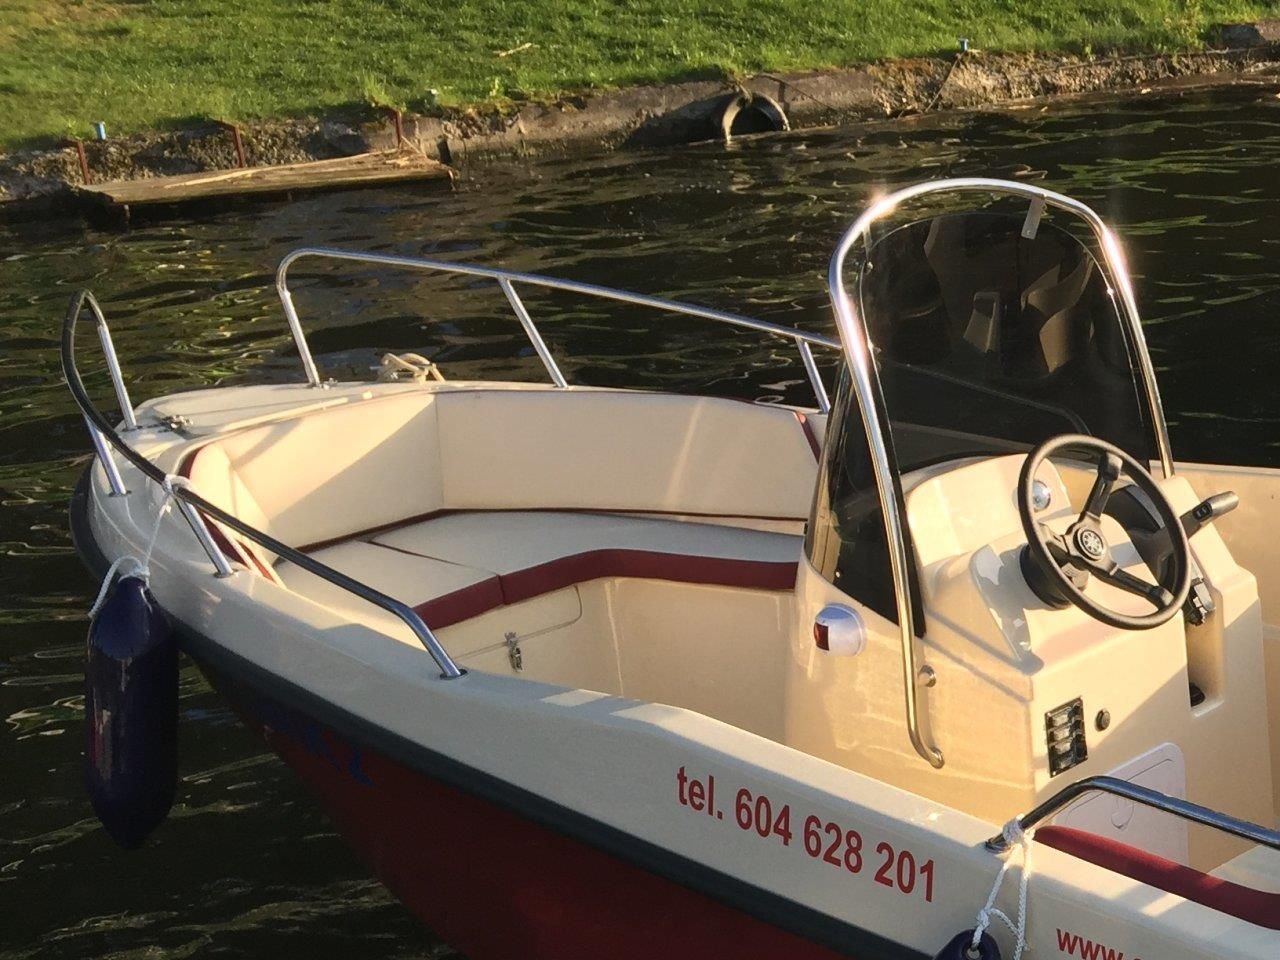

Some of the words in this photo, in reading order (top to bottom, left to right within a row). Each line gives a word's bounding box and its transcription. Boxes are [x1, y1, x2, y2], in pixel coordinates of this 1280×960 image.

[677, 766, 723, 820] tel.
[735, 788, 792, 846] 604
[804, 815, 862, 873] 628
[874, 842, 934, 903] 201
